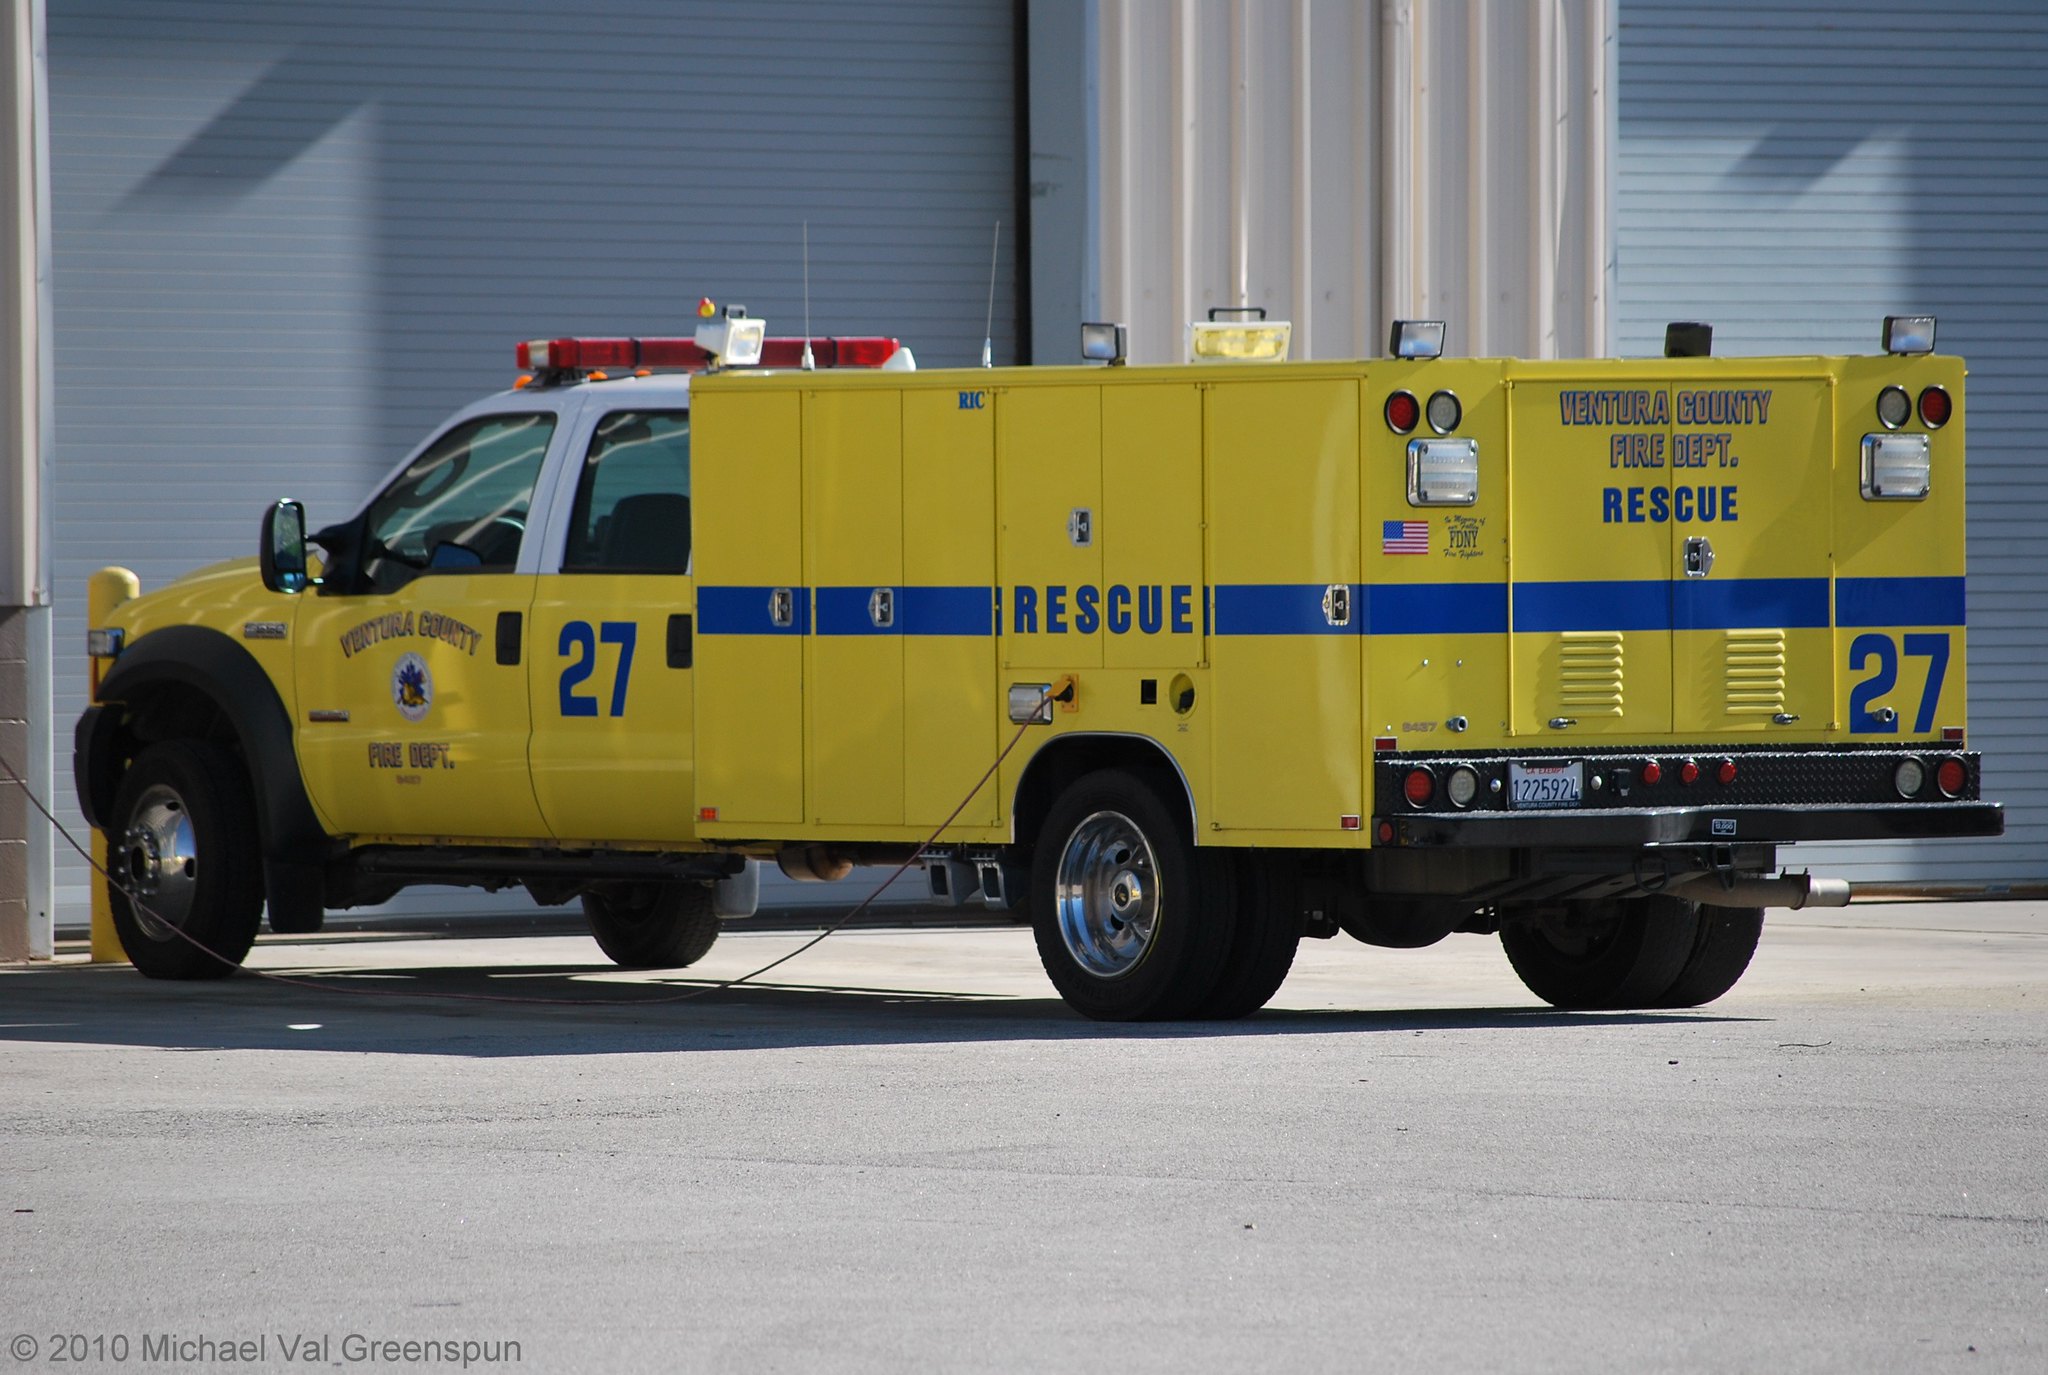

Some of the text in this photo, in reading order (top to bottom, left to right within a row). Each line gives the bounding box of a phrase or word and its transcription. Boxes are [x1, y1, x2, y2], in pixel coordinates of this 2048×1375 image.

[958, 390, 985, 409] RIC
[1559, 390, 1772, 426] VENTURA COUNTY
[1610, 433, 1739, 468] FIRE DEPT.
[1603, 485, 1739, 523] RESCUE
[1449, 530, 1479, 548] FDNY
[1014, 584, 1193, 634] RESCUE
[339, 611, 482, 658] VENTURA COUNTY
[558, 620, 637, 717] 27
[1849, 633, 1950, 734] 27
[368, 742, 455, 769] FIRE DEPT.
[1538, 767, 1565, 775] EXEMPT
[1513, 777, 1579, 801] 1225924
